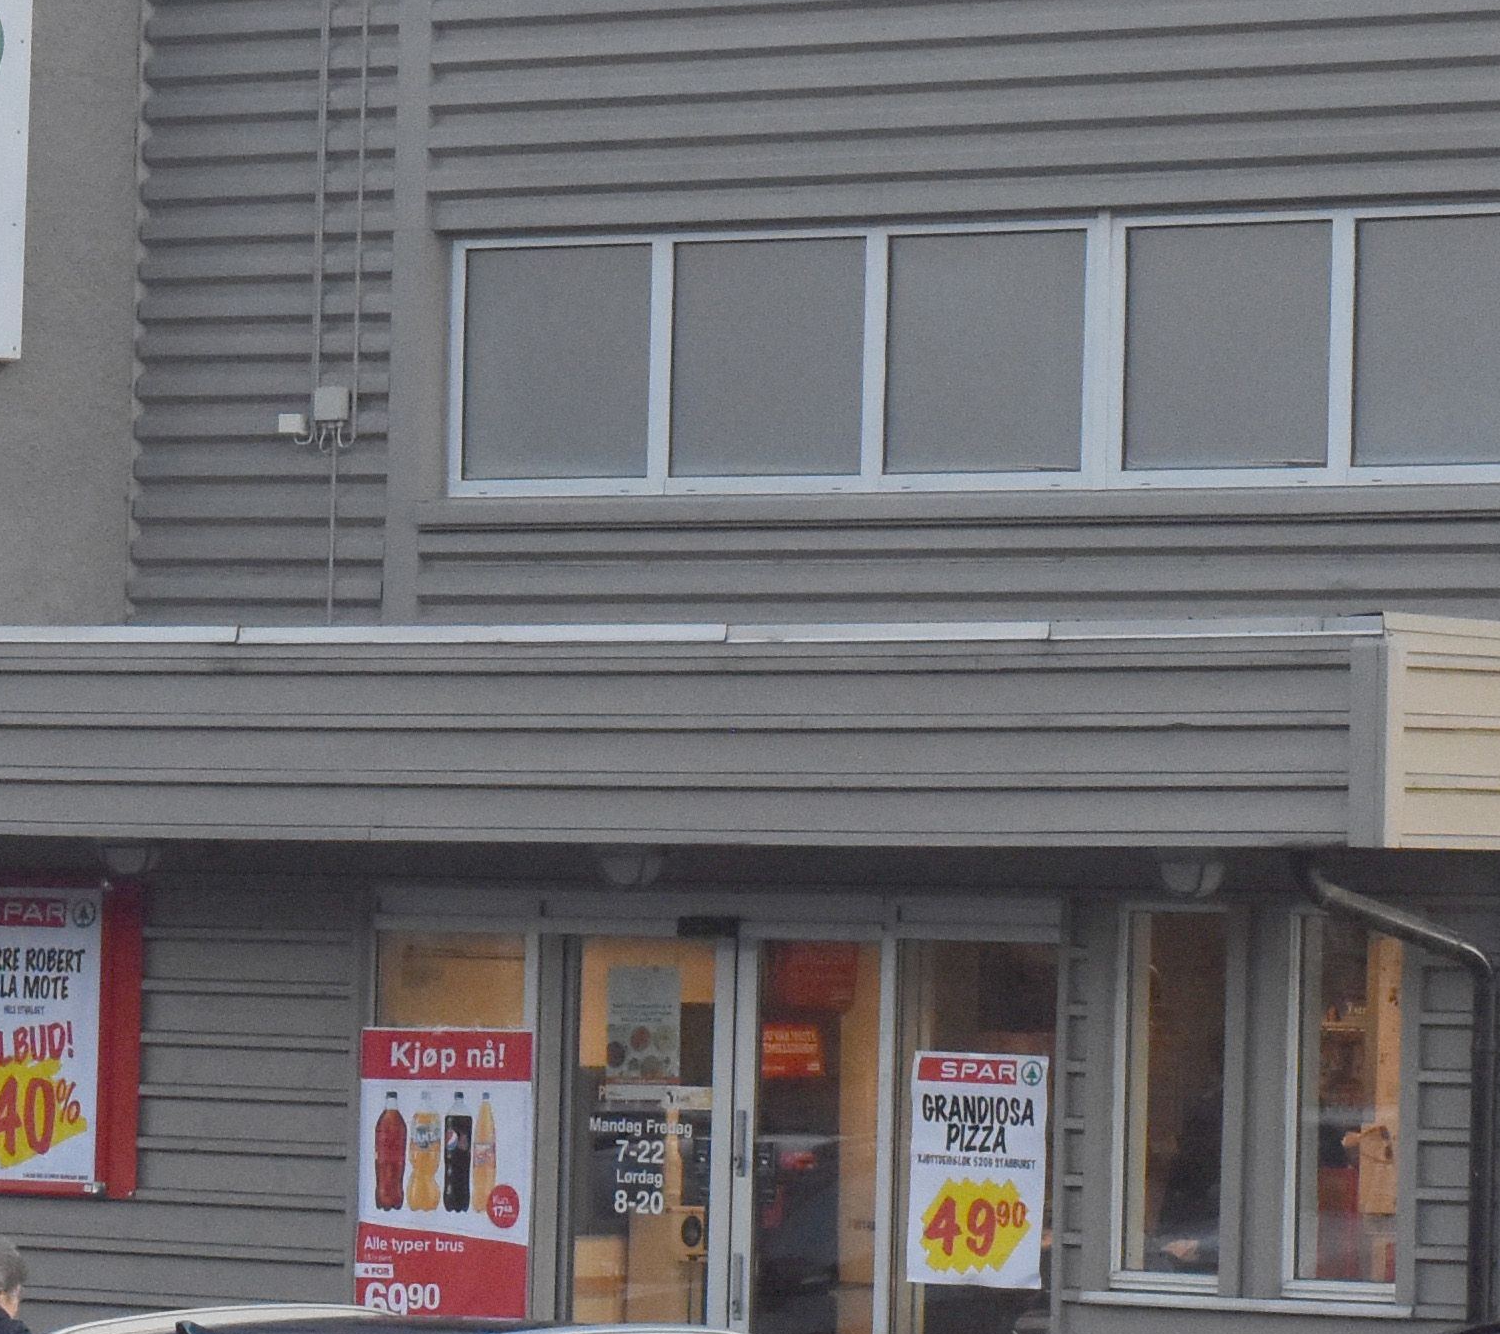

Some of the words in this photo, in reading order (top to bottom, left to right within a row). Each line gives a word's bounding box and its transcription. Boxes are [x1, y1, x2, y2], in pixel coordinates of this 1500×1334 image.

[25, 948, 85, 973] ROBERT
[0, 975, 18, 998] LA
[23, 976, 69, 1000] MOTE
[390, 1041, 456, 1073] Kjøp
[467, 1040, 506, 1068] nå!
[940, 1061, 1016, 1081] SPAR
[922, 1093, 1034, 1127] GRANDIOSA
[589, 1116, 642, 1137] Mandag
[646, 1119, 693, 1138] Fredag
[946, 1124, 1007, 1154] PIZZA
[615, 1139, 664, 1164] 7-22
[616, 1169, 663, 1188] Lørdag
[614, 1189, 664, 1214] 8-20
[364, 1235, 387, 1251] Alle
[392, 1237, 431, 1254] typer
[435, 1237, 464, 1252] brus
